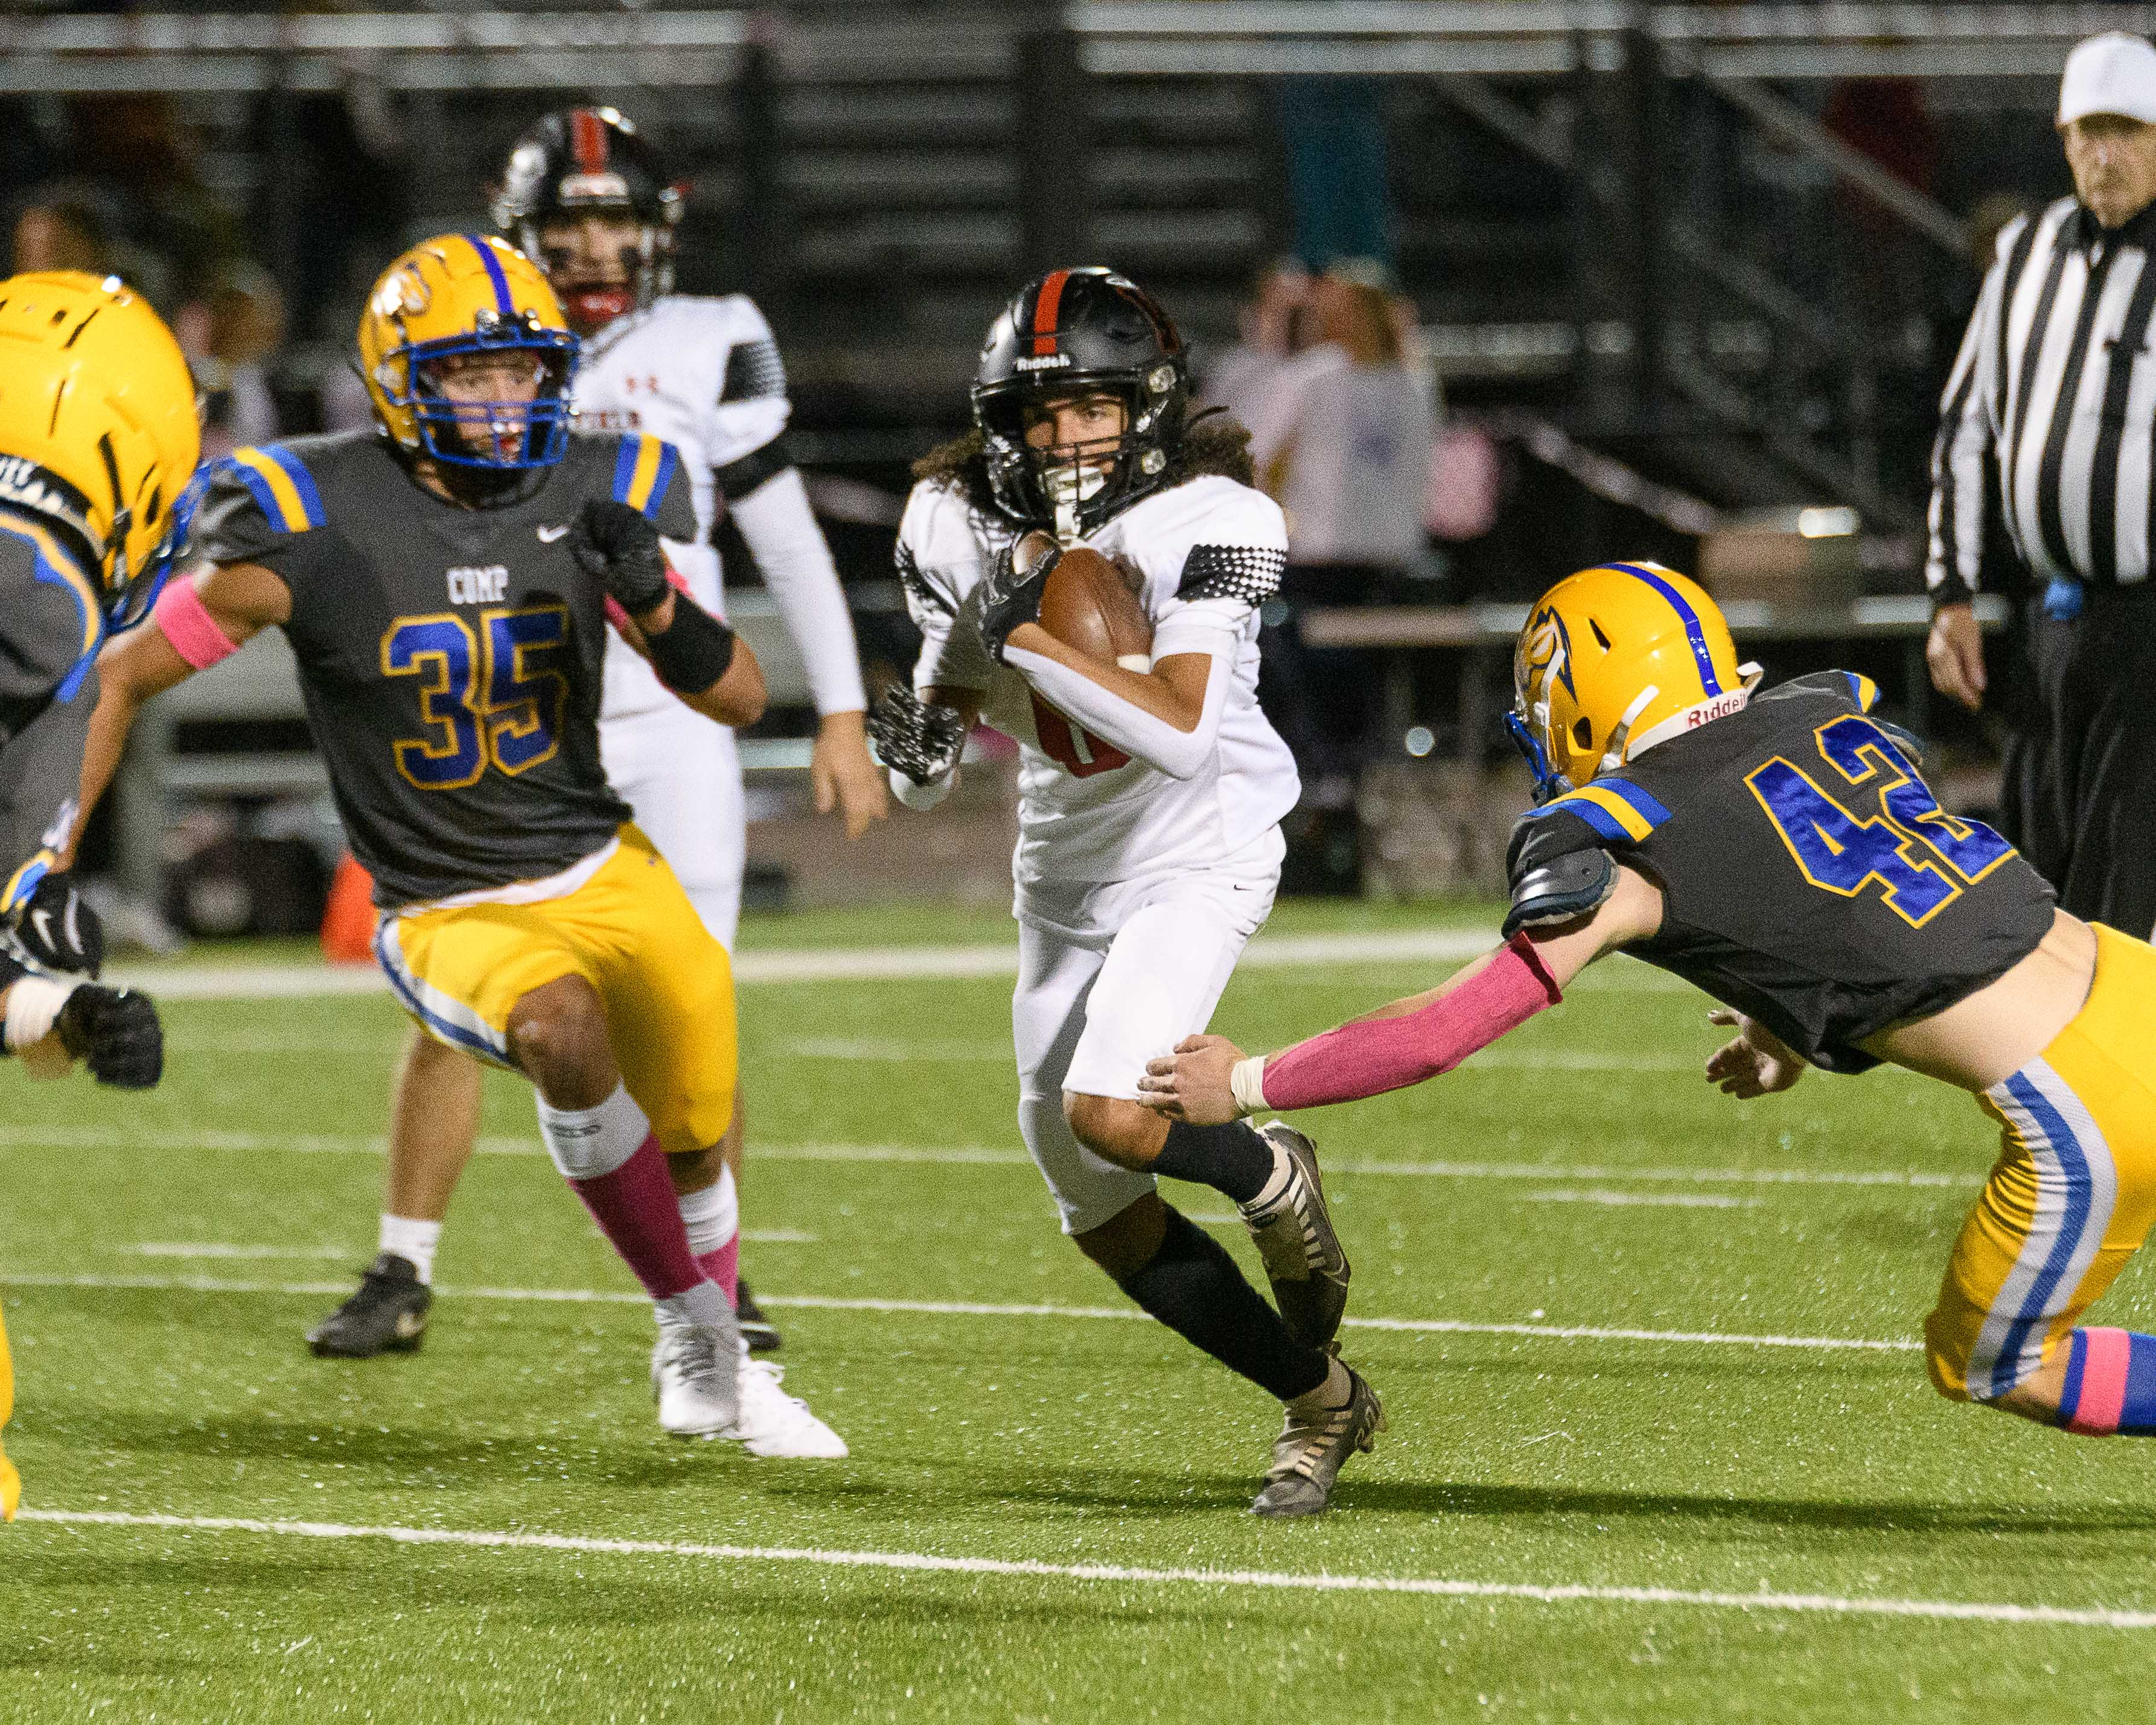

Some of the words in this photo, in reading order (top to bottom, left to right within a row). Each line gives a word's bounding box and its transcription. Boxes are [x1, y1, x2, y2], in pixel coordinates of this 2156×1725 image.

[447, 566, 508, 604] COMP
[380, 605, 569, 789] 35
[1743, 714, 2018, 929] 42
